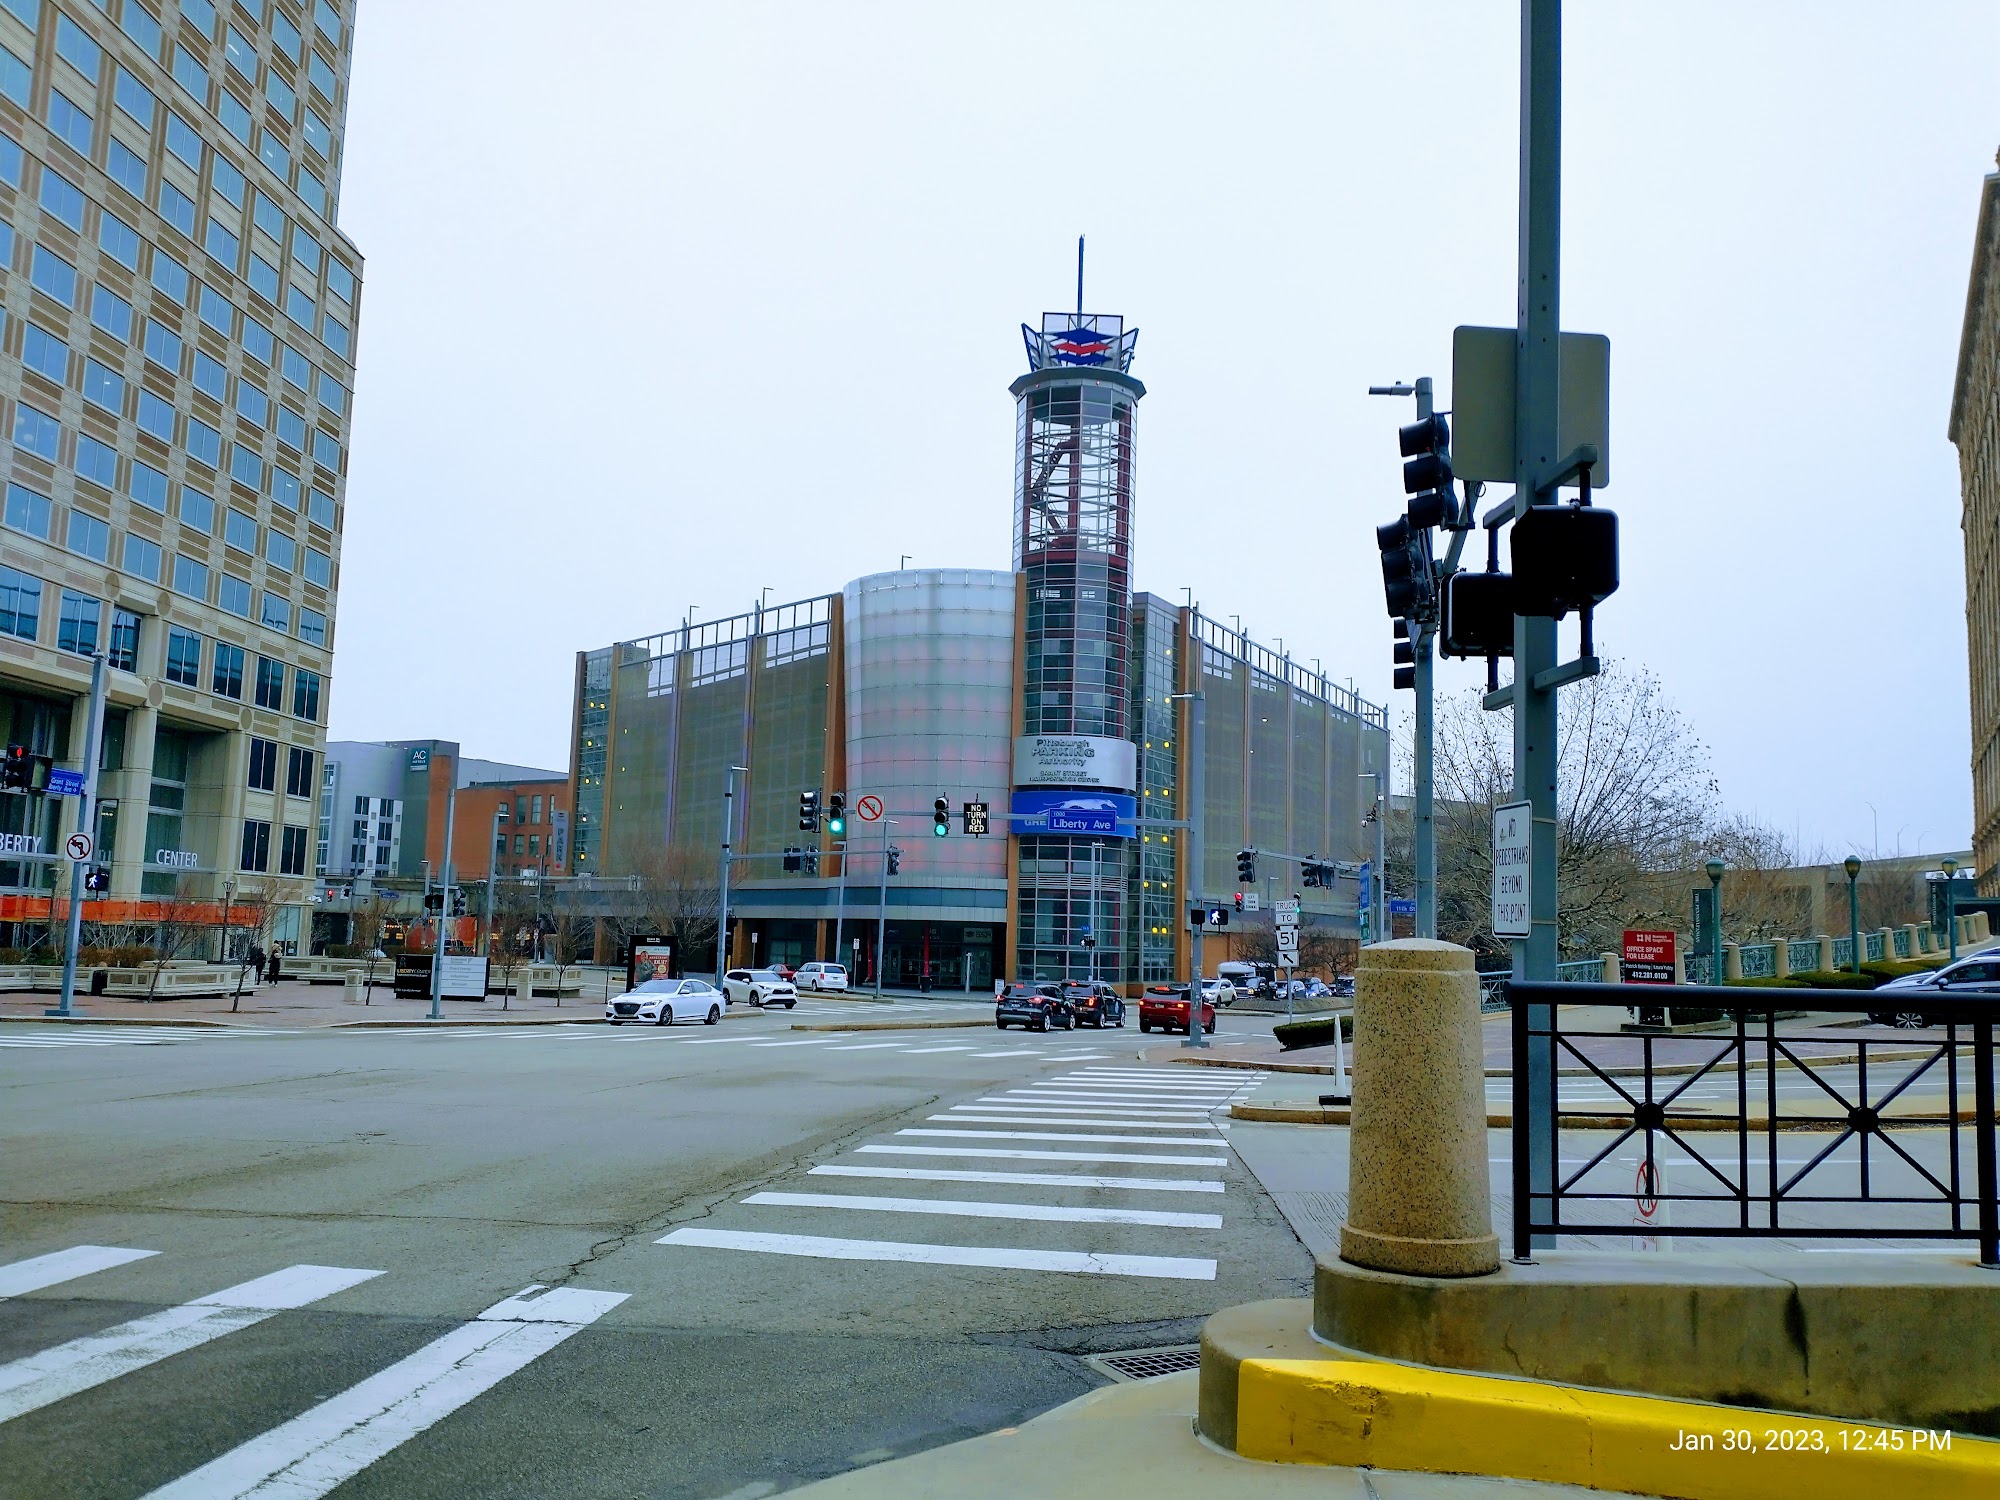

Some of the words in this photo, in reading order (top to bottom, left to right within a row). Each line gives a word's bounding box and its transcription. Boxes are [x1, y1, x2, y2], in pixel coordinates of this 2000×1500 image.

[412, 750, 426, 760] AC
[1032, 746, 1095, 757] PARKING
[1038, 757, 1087, 767] Authority
[970, 804, 982, 812] NO
[966, 811, 987, 819] TURN
[971, 818, 982, 826] ON
[1053, 818, 1088, 830] Liberty
[1093, 819, 1111, 829] Ave
[968, 825, 985, 833] RED
[156, 848, 198, 868] CENTER
[1496, 845, 1529, 867] PEDESTRIANS
[1501, 875, 1523, 894] BEYOND
[1276, 901, 1296, 910] TRUCK
[1281, 914, 1292, 922] TO
[1497, 903, 1509, 922] THIS
[1510, 903, 1526, 923] POINT
[1280, 931, 1295, 945] 51
[1645, 946, 1664, 954] SPACE
